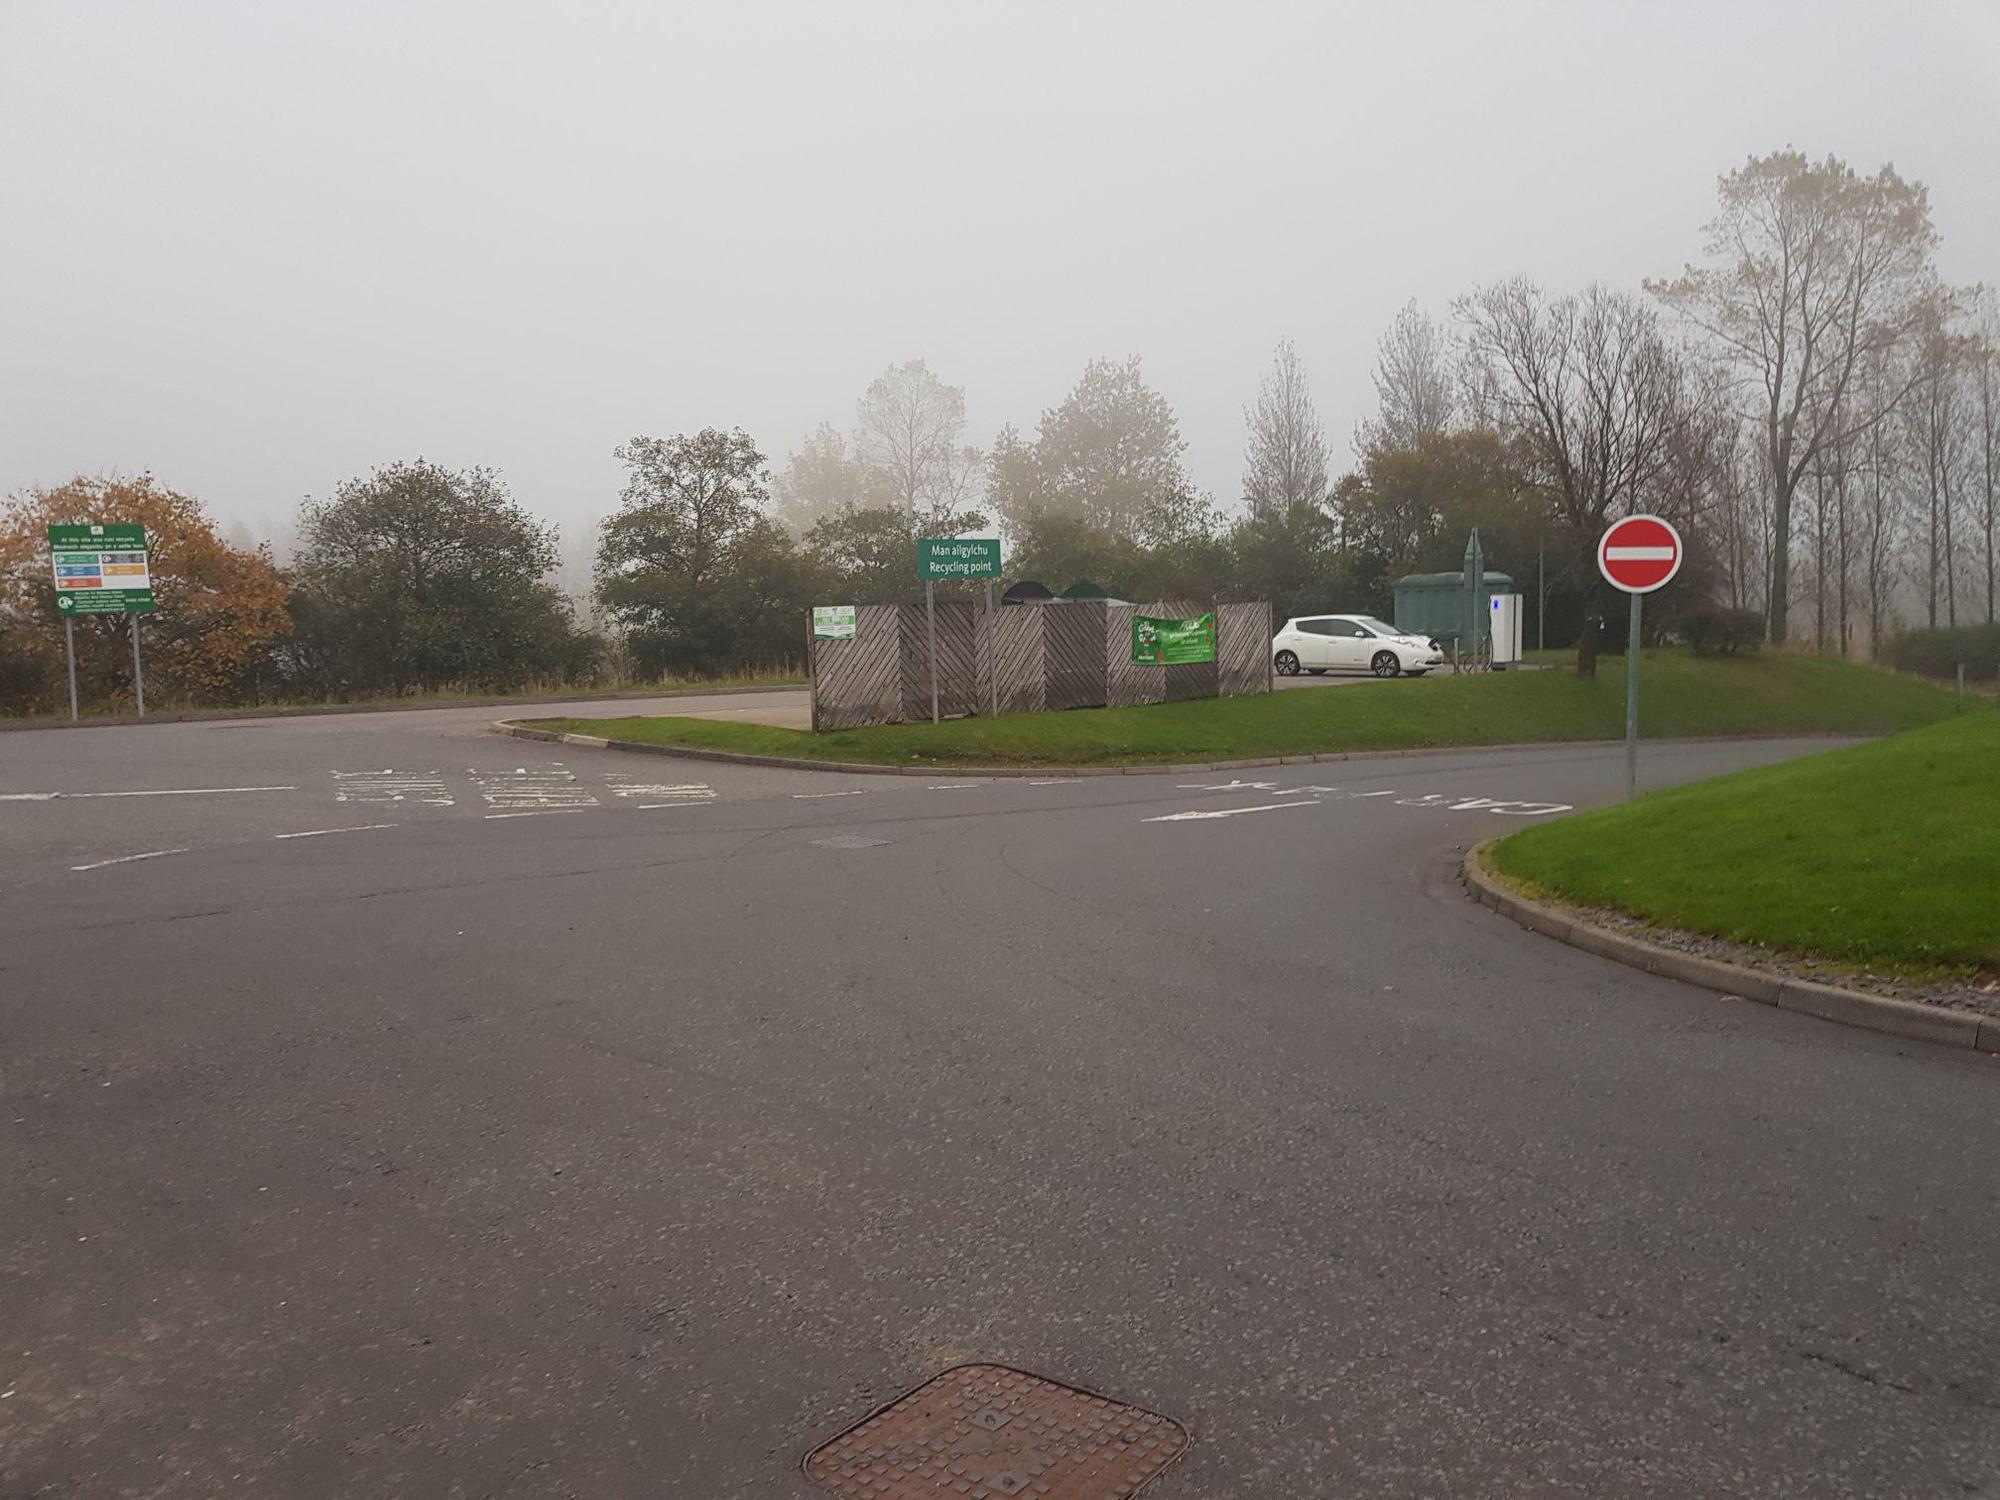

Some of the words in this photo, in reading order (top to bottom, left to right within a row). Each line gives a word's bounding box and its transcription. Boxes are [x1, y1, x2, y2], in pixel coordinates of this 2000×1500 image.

[931, 544, 950, 556] Man
[952, 544, 988, 558] ailgylchu
[929, 561, 969, 575] Recycling
[971, 561, 992, 574] point
